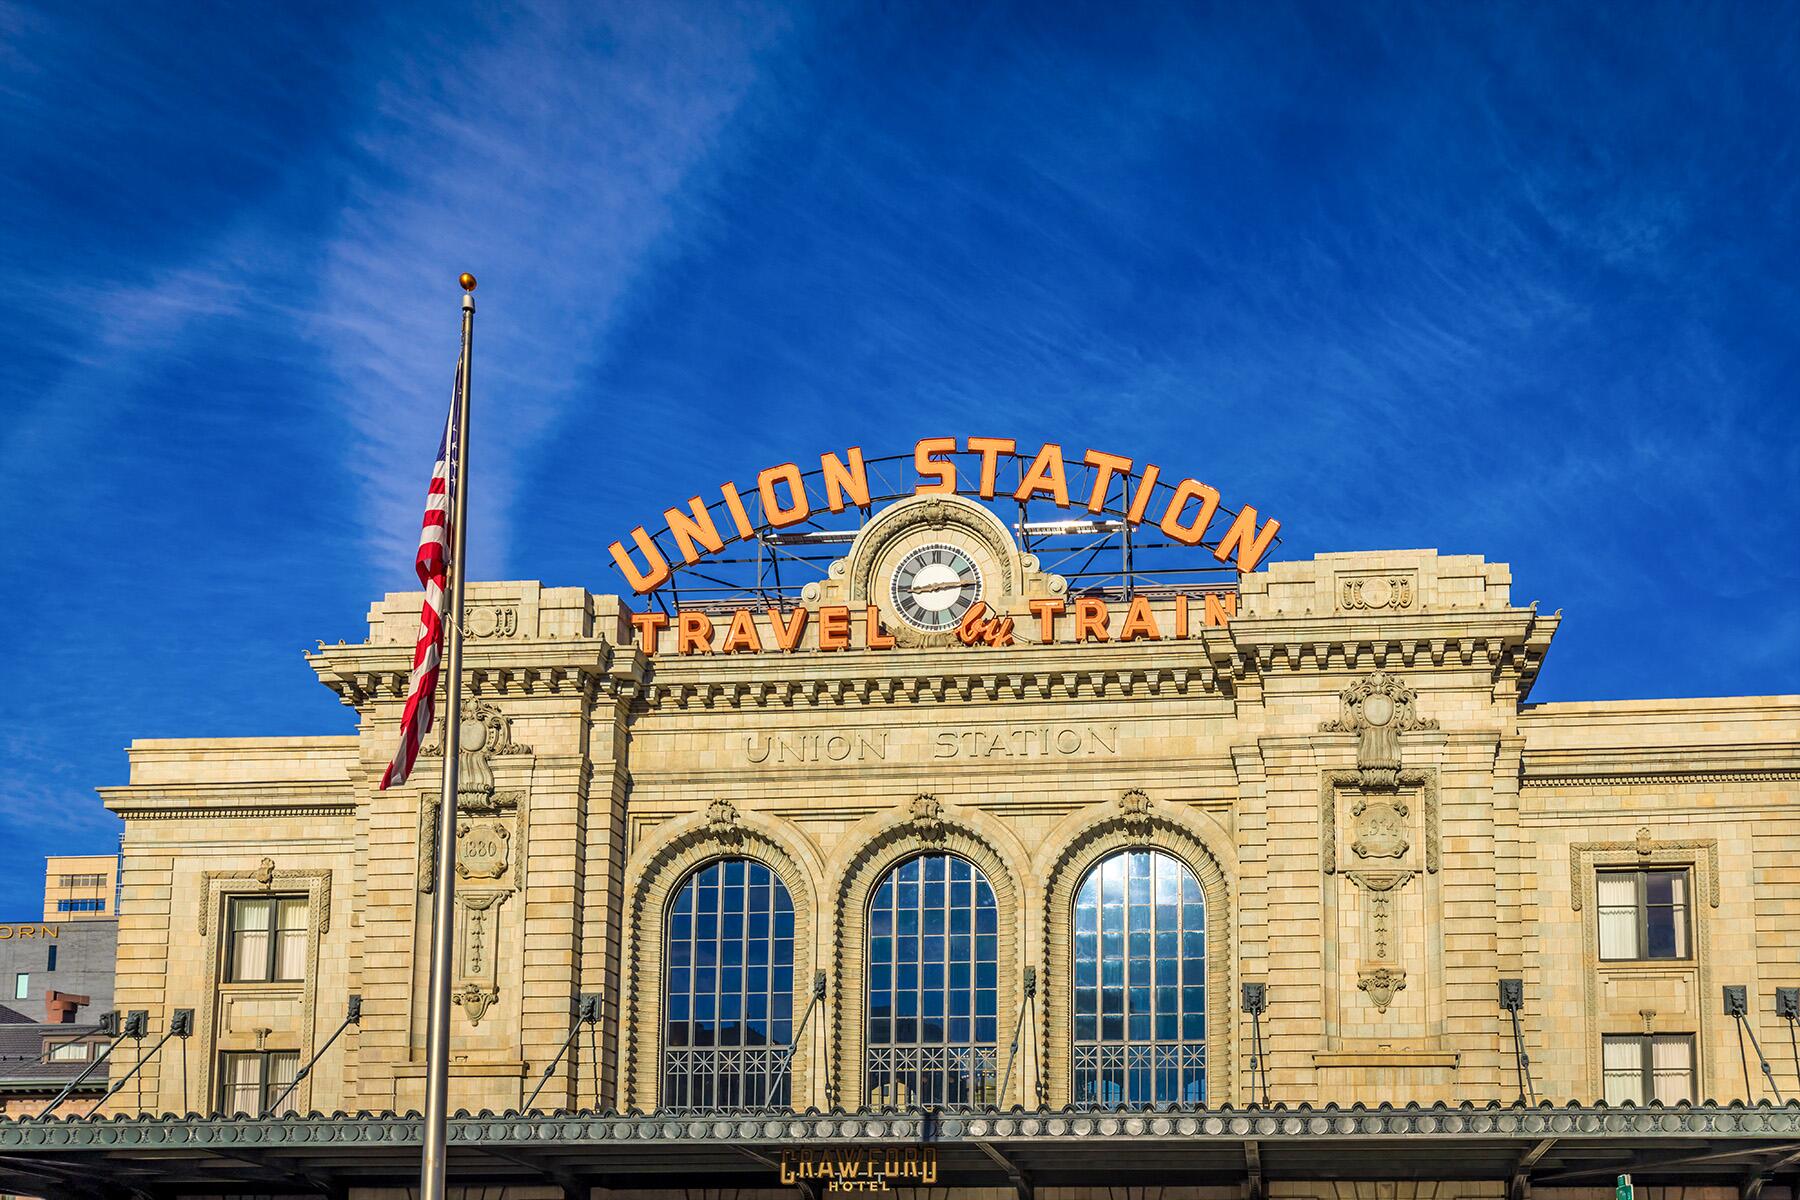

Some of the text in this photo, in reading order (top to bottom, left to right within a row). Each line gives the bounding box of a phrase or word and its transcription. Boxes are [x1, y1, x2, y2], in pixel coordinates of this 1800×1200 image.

[608, 436, 1281, 595] UNION STATION
[631, 594, 1238, 656] TRAVEL by TRAIN
[744, 727, 1118, 764] UNION STATION
[464, 841, 497, 857] 1880
[780, 1146, 937, 1185] CRAWFORD
[829, 1181, 890, 1192] HOTEL
